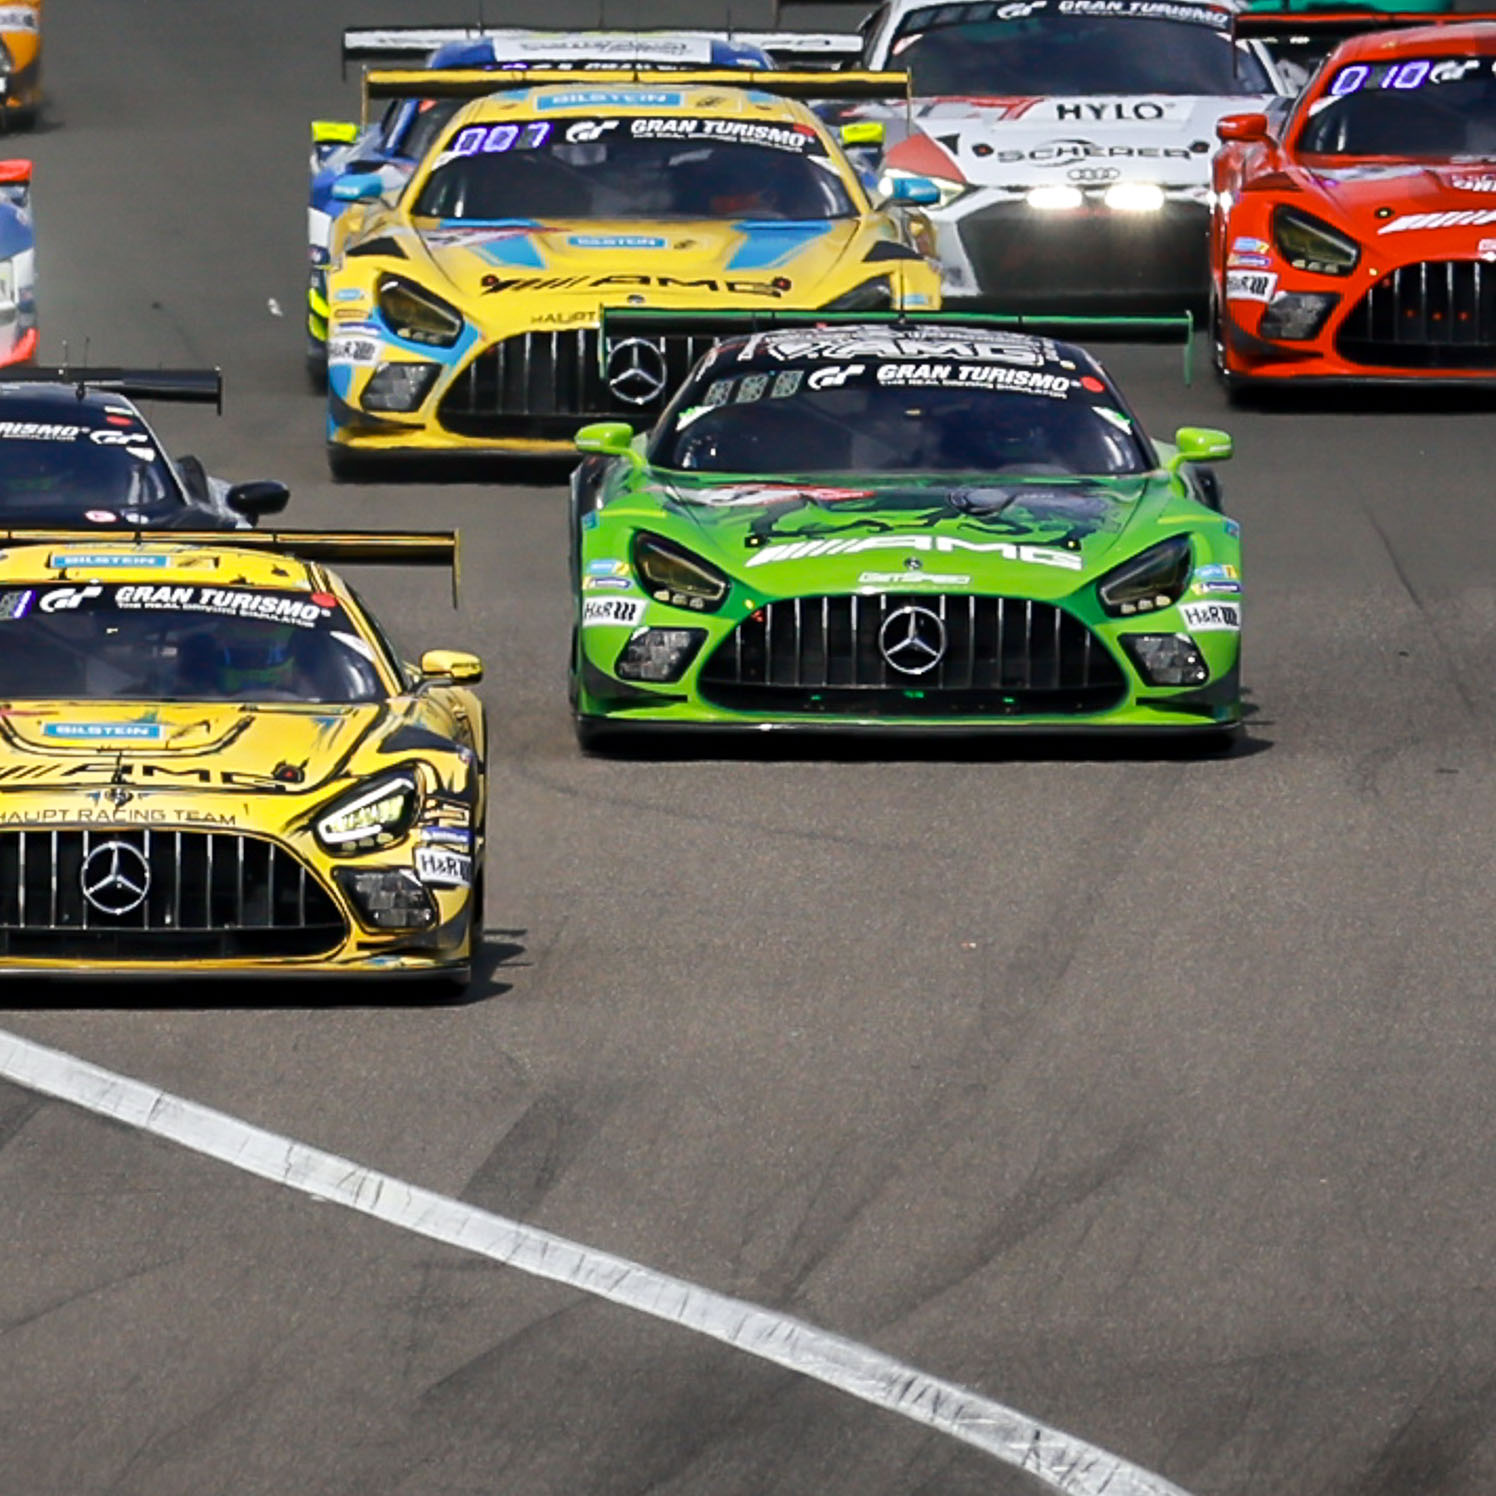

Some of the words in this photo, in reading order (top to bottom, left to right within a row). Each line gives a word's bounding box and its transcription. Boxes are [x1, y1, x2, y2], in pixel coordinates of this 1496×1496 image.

[1057, 0, 1122, 13] GRAN
[1129, 1, 1229, 26] TURISMO
[1056, 102, 1164, 121] HYLO
[630, 119, 698, 134] GRAN
[703, 120, 807, 147] TURISMO
[997, 144, 1192, 164] SCHERER
[876, 364, 952, 380] GRAN
[958, 365, 1071, 393] TURISMO
[114, 585, 195, 604] GRAN
[199, 587, 321, 622] TURISMO
[77, 807, 166, 823] RACING
[173, 808, 237, 826] TEAM
